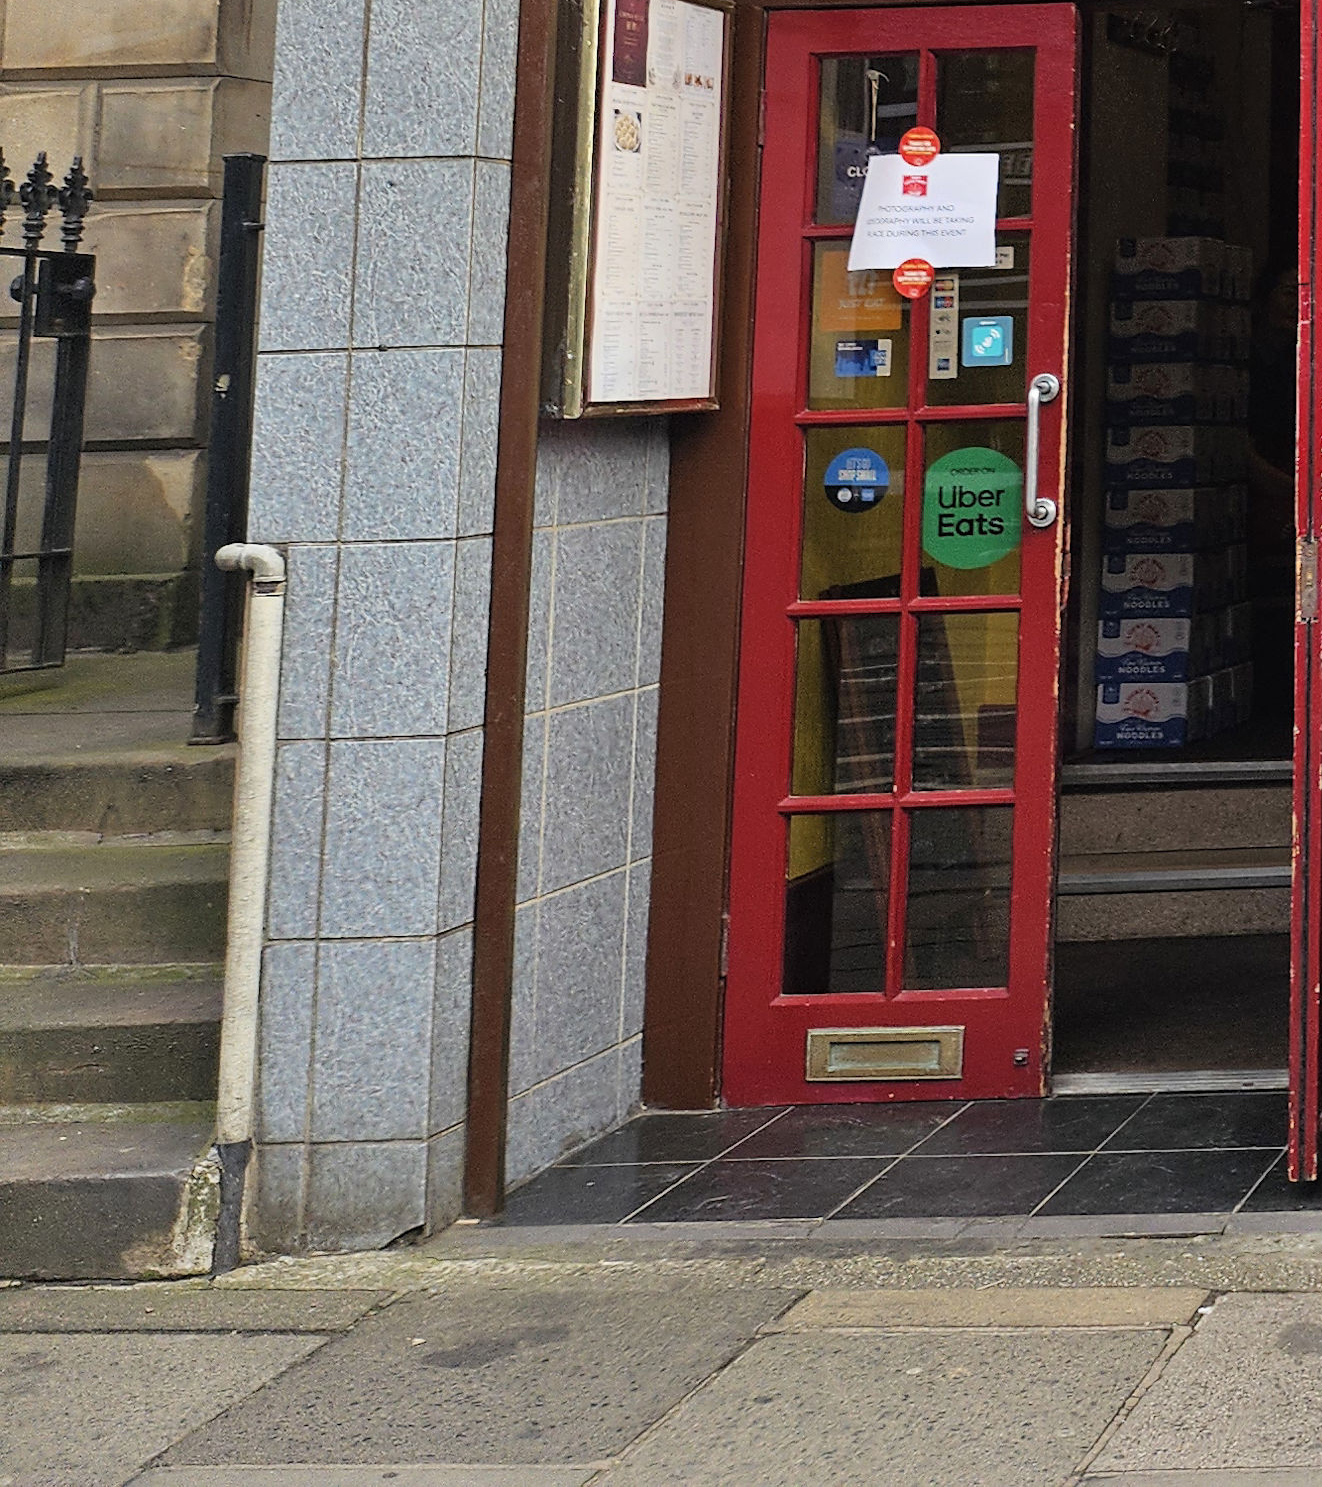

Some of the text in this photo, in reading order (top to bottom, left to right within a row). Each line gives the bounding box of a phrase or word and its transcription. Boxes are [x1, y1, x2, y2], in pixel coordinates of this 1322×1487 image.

[847, 165, 869, 178] CLO
[938, 486, 1006, 509] Uber
[938, 514, 1005, 537] Eats
